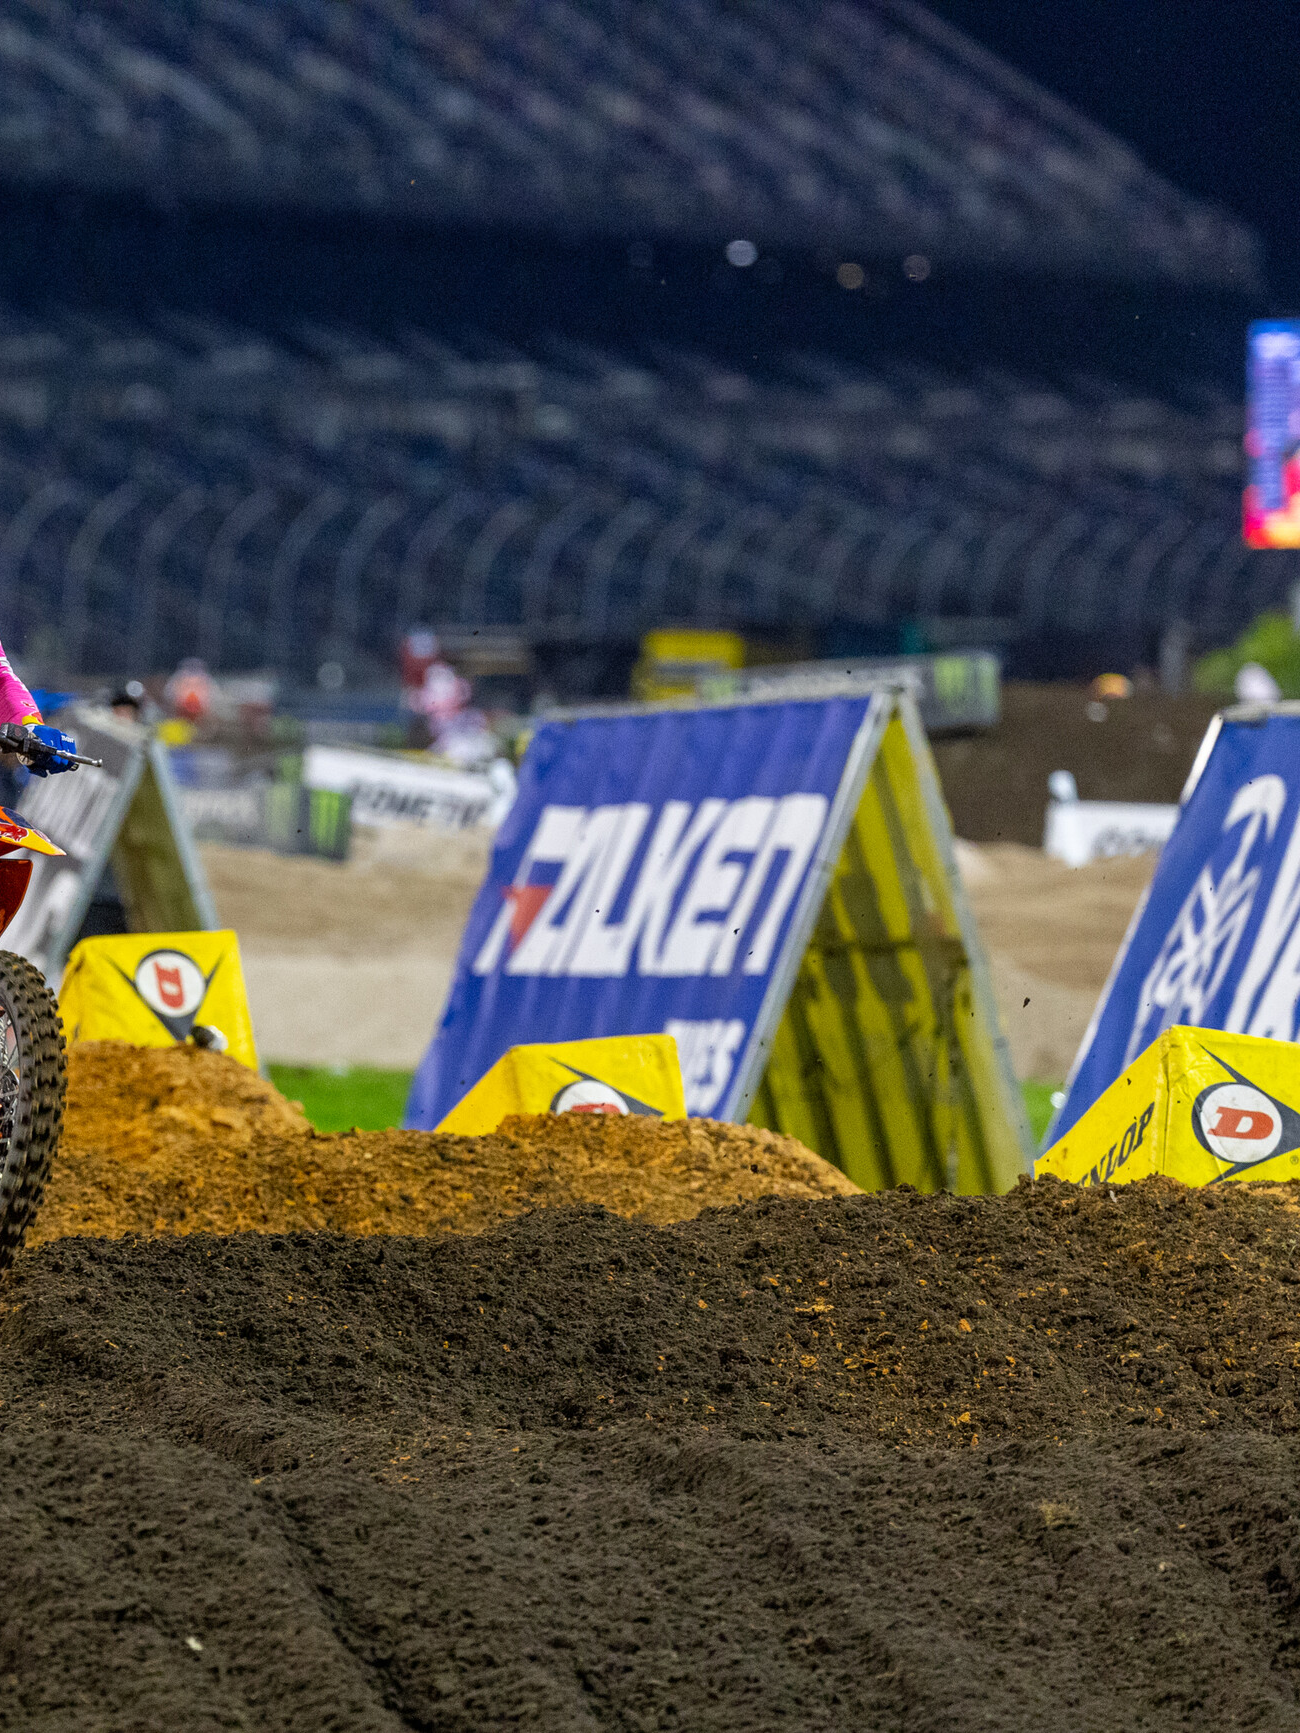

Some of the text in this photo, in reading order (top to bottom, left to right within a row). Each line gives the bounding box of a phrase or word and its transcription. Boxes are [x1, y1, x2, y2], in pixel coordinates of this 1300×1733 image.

[474, 793, 829, 977] FALKEN
[153, 961, 186, 1010] D
[1078, 1102, 1155, 1187] NLOP
[1206, 1106, 1274, 1140] D
